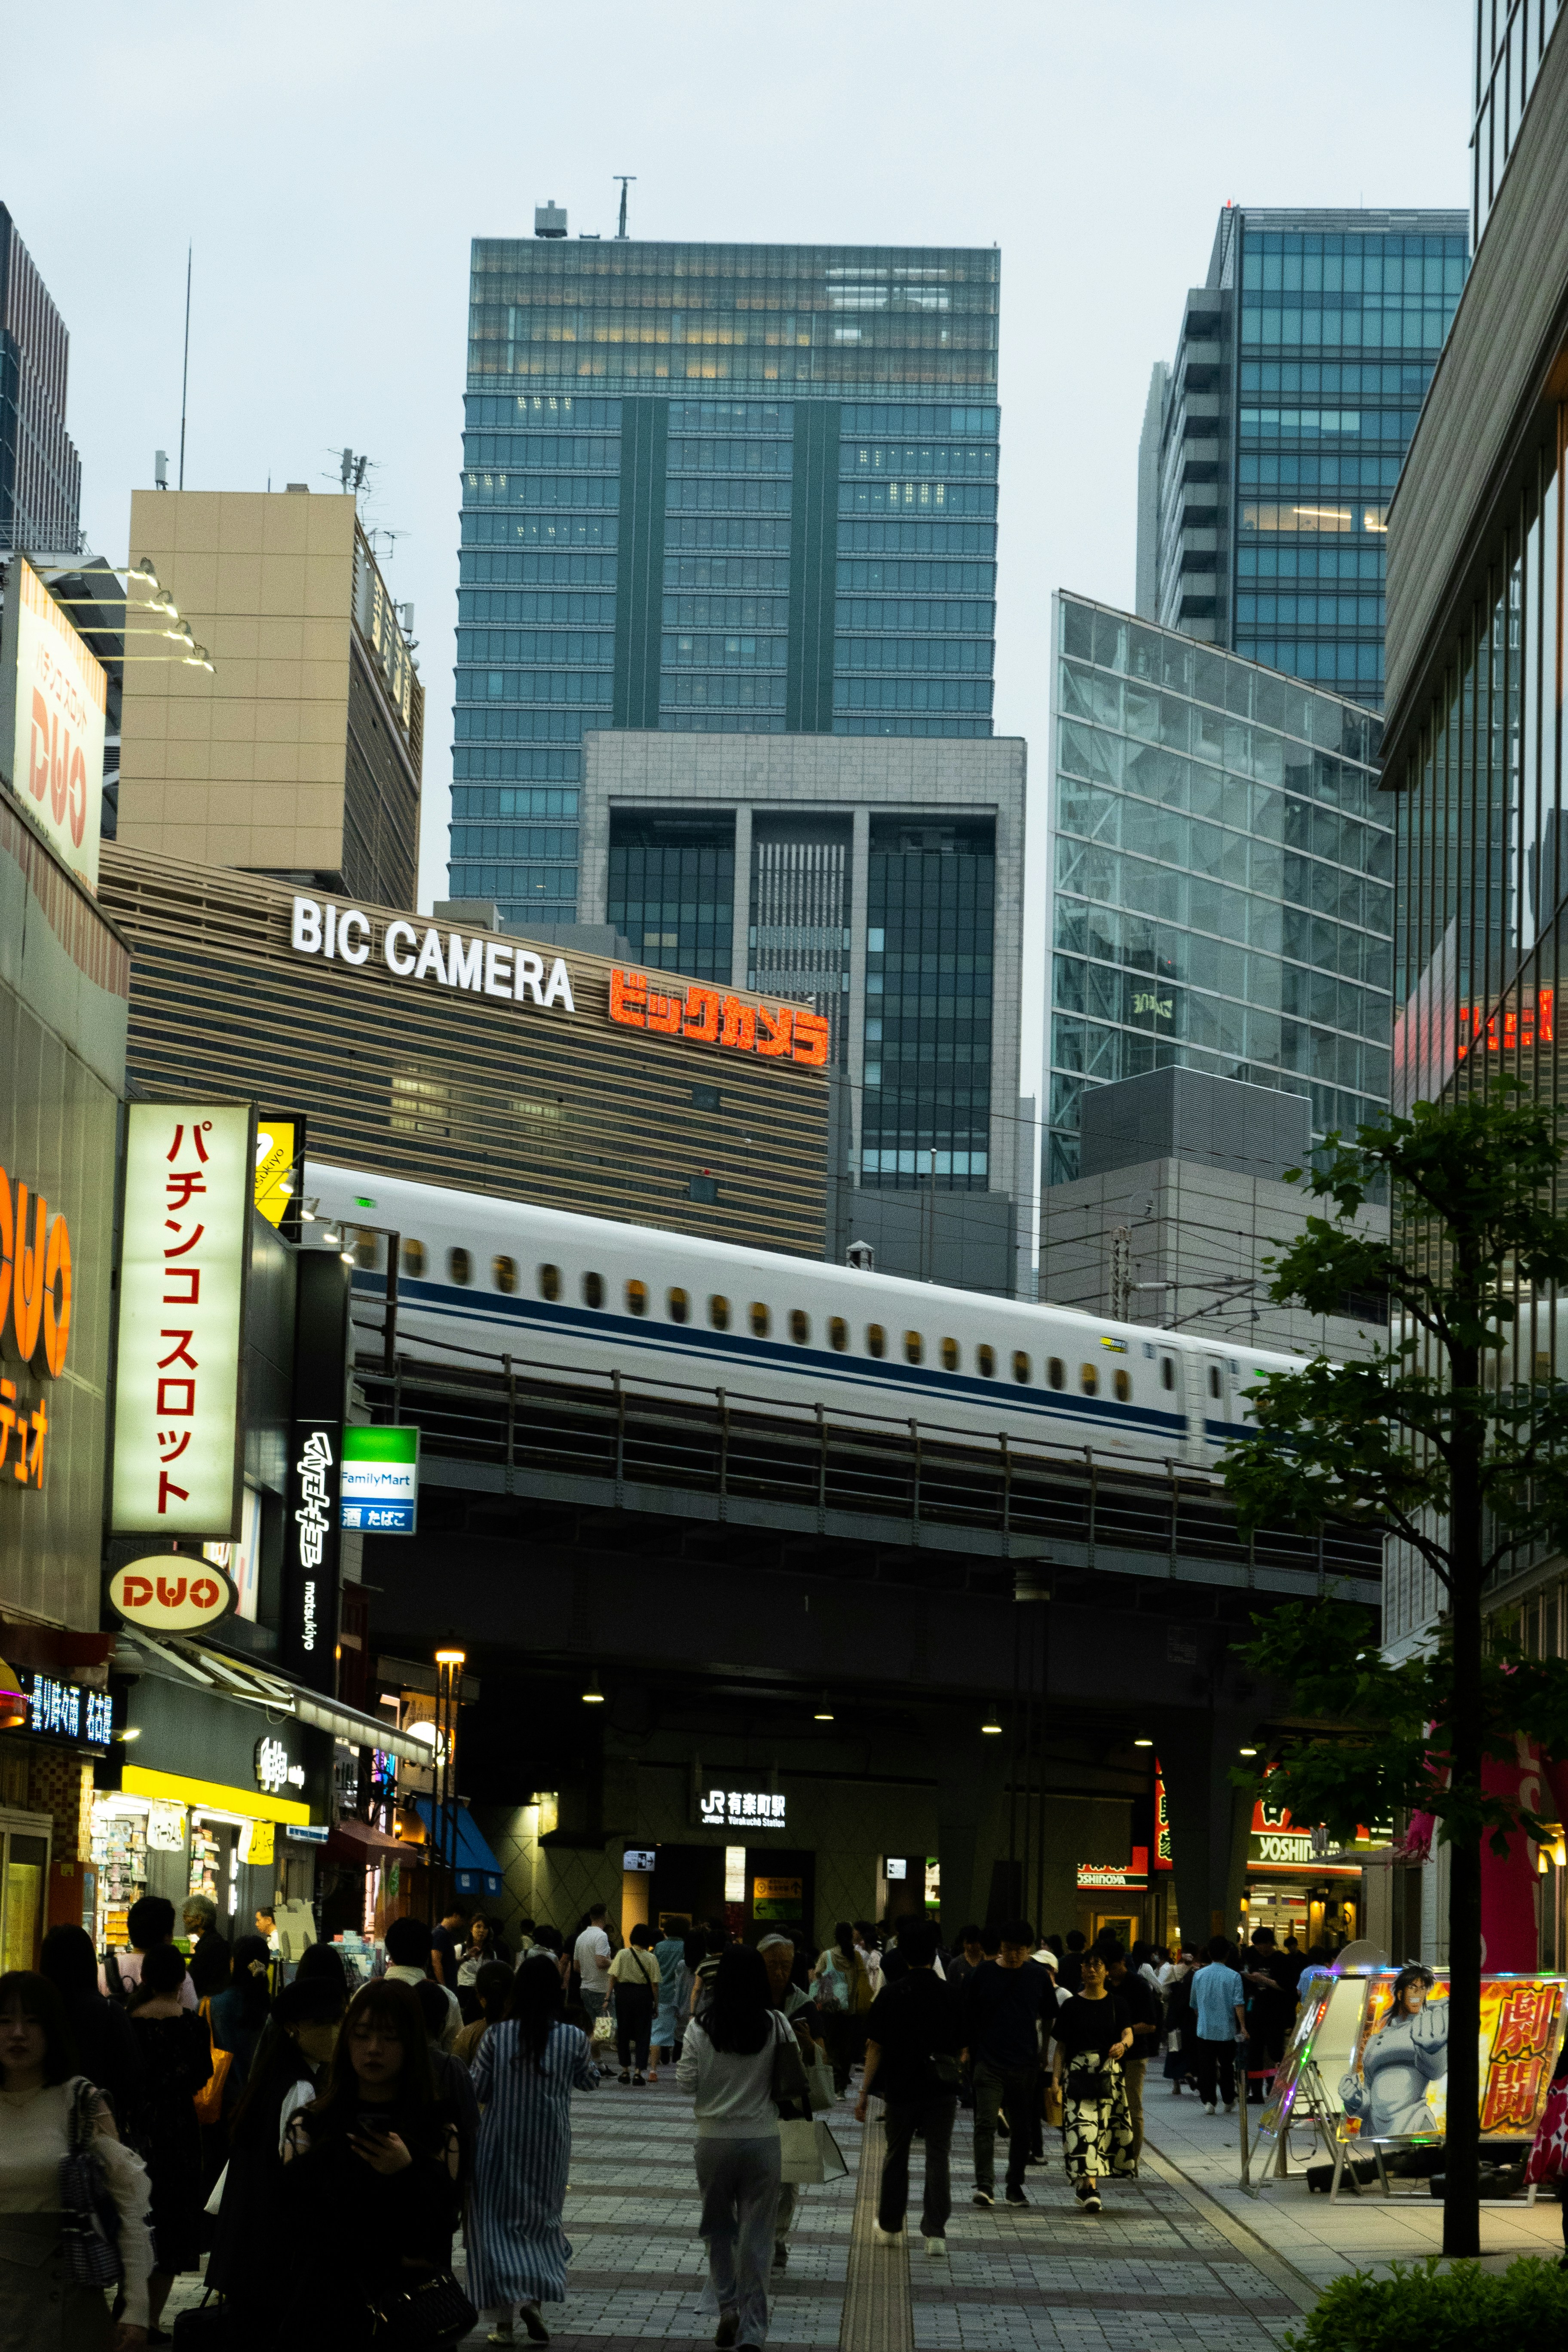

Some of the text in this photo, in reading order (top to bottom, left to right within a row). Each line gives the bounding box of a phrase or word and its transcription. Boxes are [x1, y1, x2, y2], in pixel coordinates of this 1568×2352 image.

[29, 686, 86, 849] DUO
[292, 896, 576, 1013] BIC CAMERA
[609, 968, 829, 1066] ビックカメラ
[156, 1120, 213, 1514] パチンコ スロット
[342, 1473, 410, 1487] FamilyMart
[342, 1508, 405, 1528] 酒 たばこ
[122, 1576, 220, 1609] DUO
[304, 1581, 317, 1651] matsukiyo
[86, 1690, 113, 1745] 名古屋
[701, 1790, 786, 1817] JR 有楽町駅
[762, 1817, 786, 1828] Station
[1259, 1836, 1340, 1862] YOSHIN
